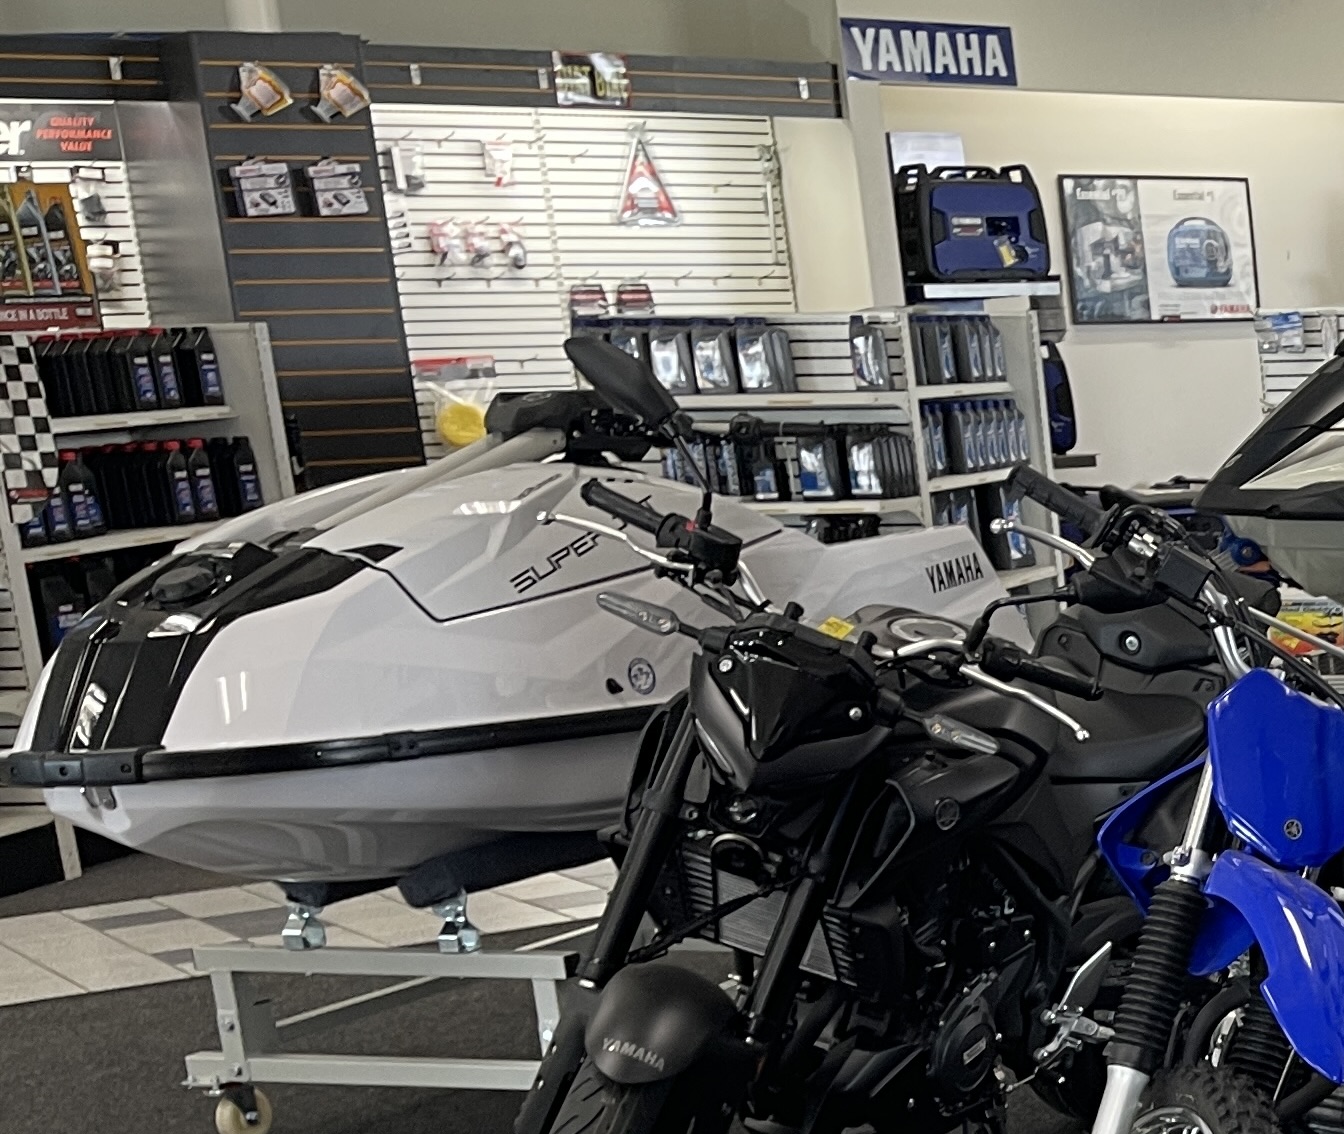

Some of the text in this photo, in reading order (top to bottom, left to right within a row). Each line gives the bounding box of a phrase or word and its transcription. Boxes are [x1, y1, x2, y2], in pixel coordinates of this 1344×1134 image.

[850, 26, 1008, 77] YAMAHA
[925, 552, 985, 594] YAMAHA
[602, 1037, 665, 1072] YAMAHA
